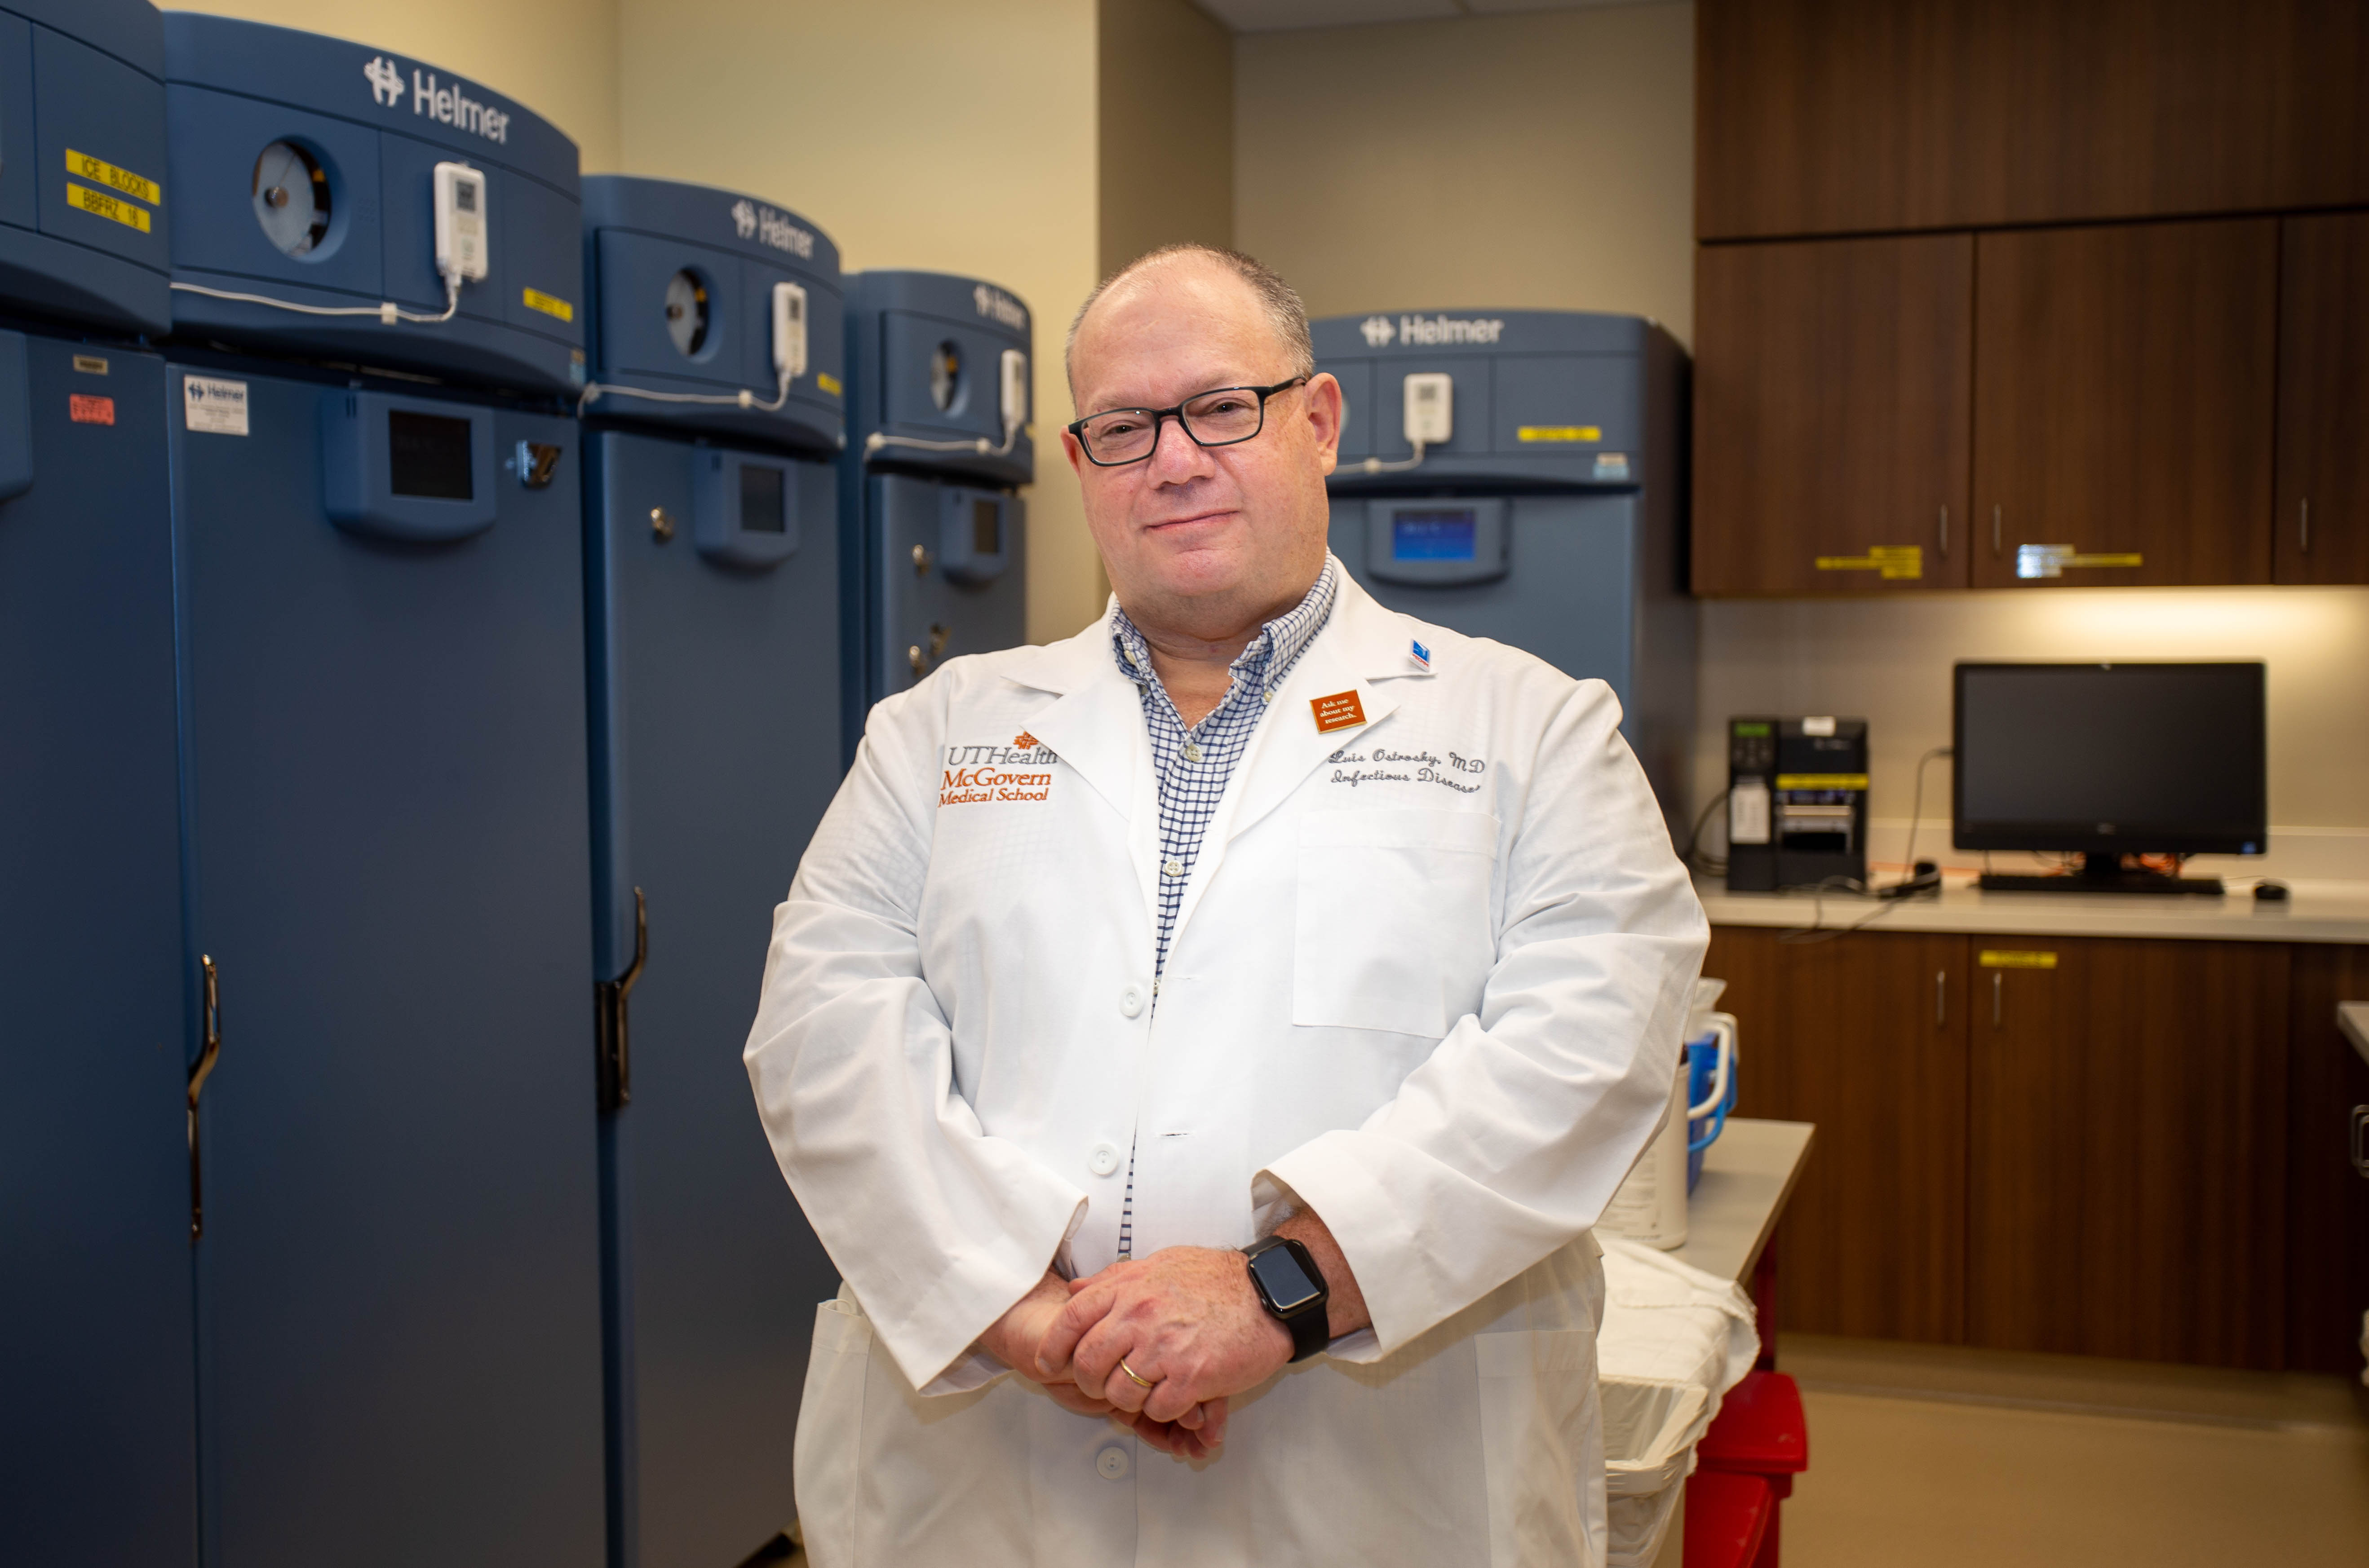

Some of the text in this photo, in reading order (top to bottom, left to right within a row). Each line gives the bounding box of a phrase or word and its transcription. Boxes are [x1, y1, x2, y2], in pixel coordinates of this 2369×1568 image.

[413, 69, 509, 144] Helmer
[82, 157, 149, 200] ICE BLOCKS
[758, 207, 814, 260] Helmer
[1400, 315, 1504, 345] Helmer
[1320, 708, 1342, 717] about
[1321, 701, 1337, 709] Ask
[948, 746, 1057, 765] UTHealth
[1328, 750, 1366, 764] Luis
[1448, 751, 1485, 773] MD
[940, 767, 1051, 791] McGovern
[1330, 769, 1411, 787] Infectious
[937, 787, 1049, 808] Medical School
